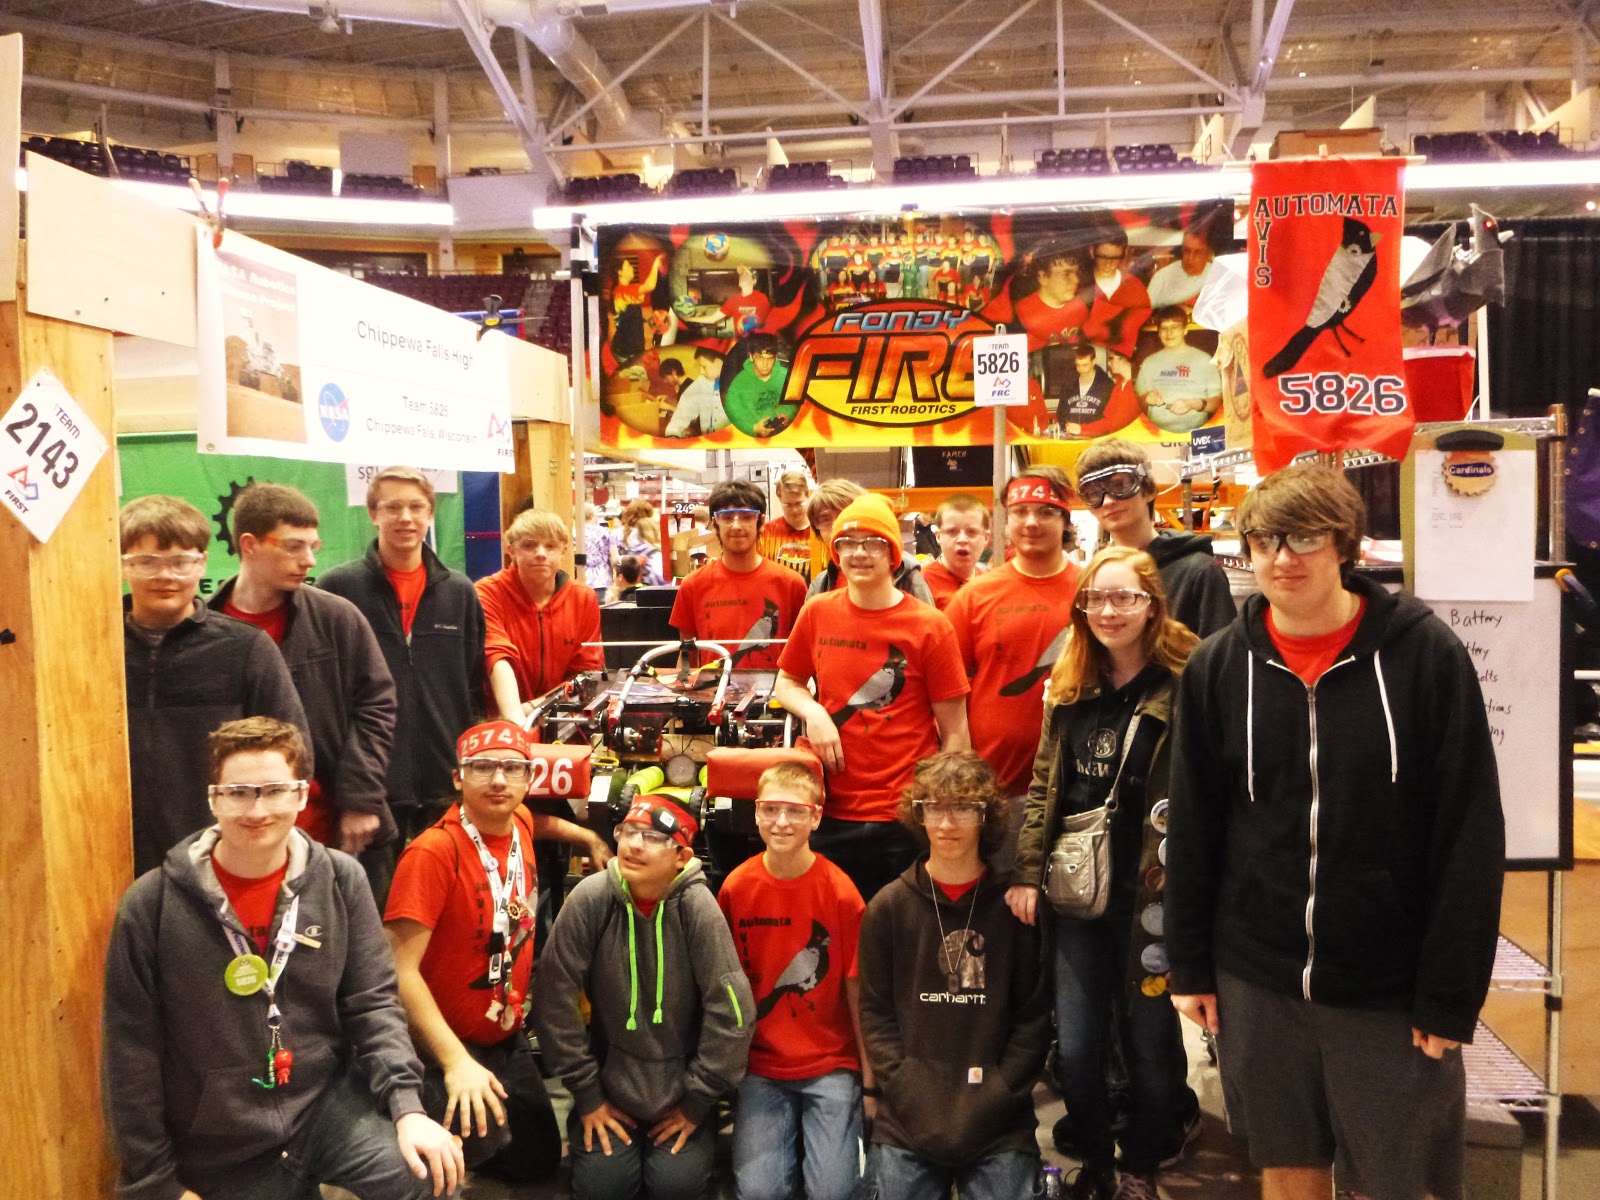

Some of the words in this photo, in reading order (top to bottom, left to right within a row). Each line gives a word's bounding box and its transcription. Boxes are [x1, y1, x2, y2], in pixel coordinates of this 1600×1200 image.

[1254, 192, 1399, 219] AUTOMATA
[833, 309, 971, 332] FONDY
[357, 320, 423, 353] Chippewa
[426, 340, 450, 361] Falls
[977, 351, 1020, 375] 5826
[402, 395, 426, 412] Team
[991, 389, 1010, 397] FRC
[1278, 372, 1408, 415] 5826
[850, 405, 888, 416] FIRST
[890, 404, 956, 415] ROBOTICS
[55, 406, 81, 439] TEAM
[366, 418, 415, 437] Chippewa
[5, 402, 79, 489] 2143
[1449, 465, 1492, 474] Cardinals
[4, 489, 29, 514] FIRST
[919, 991, 985, 1004] carhartt
